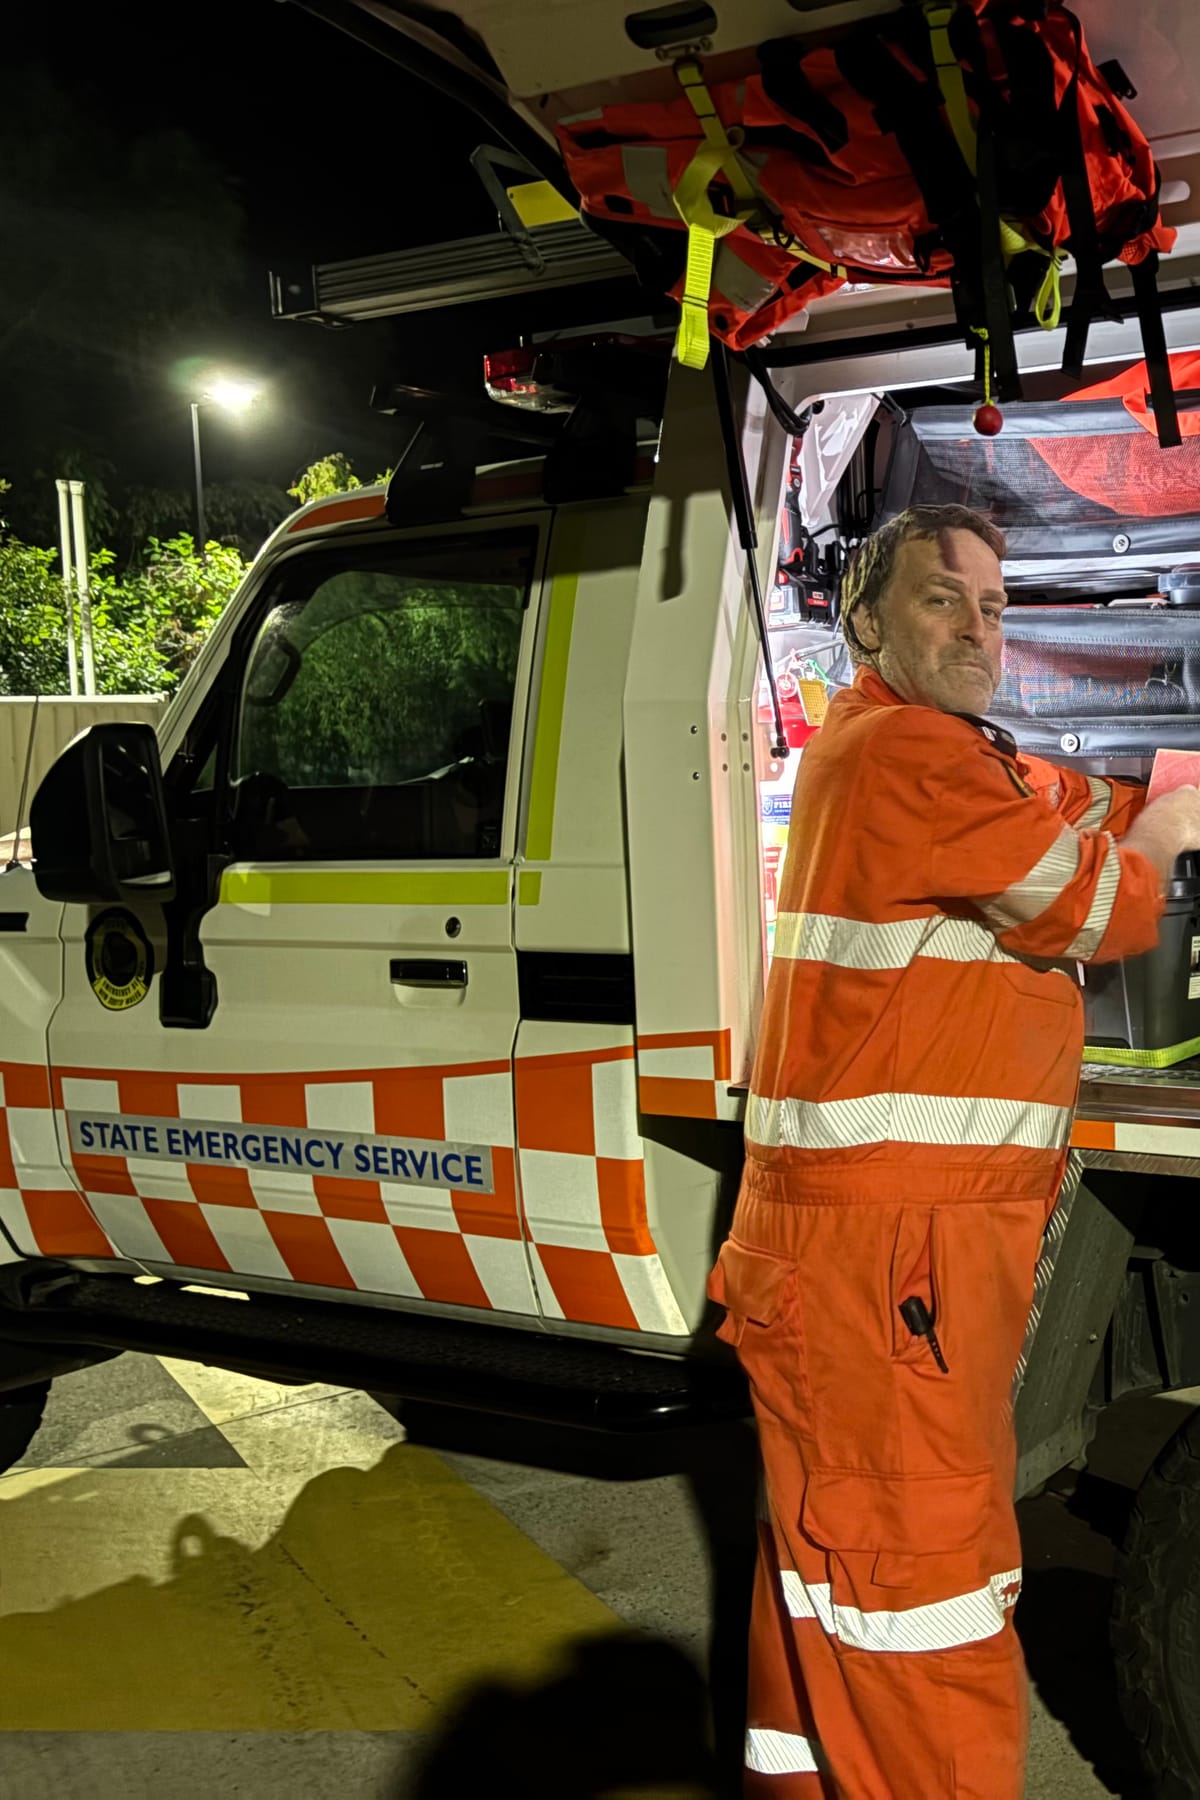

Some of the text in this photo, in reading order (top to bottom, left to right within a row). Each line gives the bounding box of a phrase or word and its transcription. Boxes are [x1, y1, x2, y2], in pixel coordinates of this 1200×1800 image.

[80, 1121, 484, 1186] STATE EMERGENCY SERVICE
